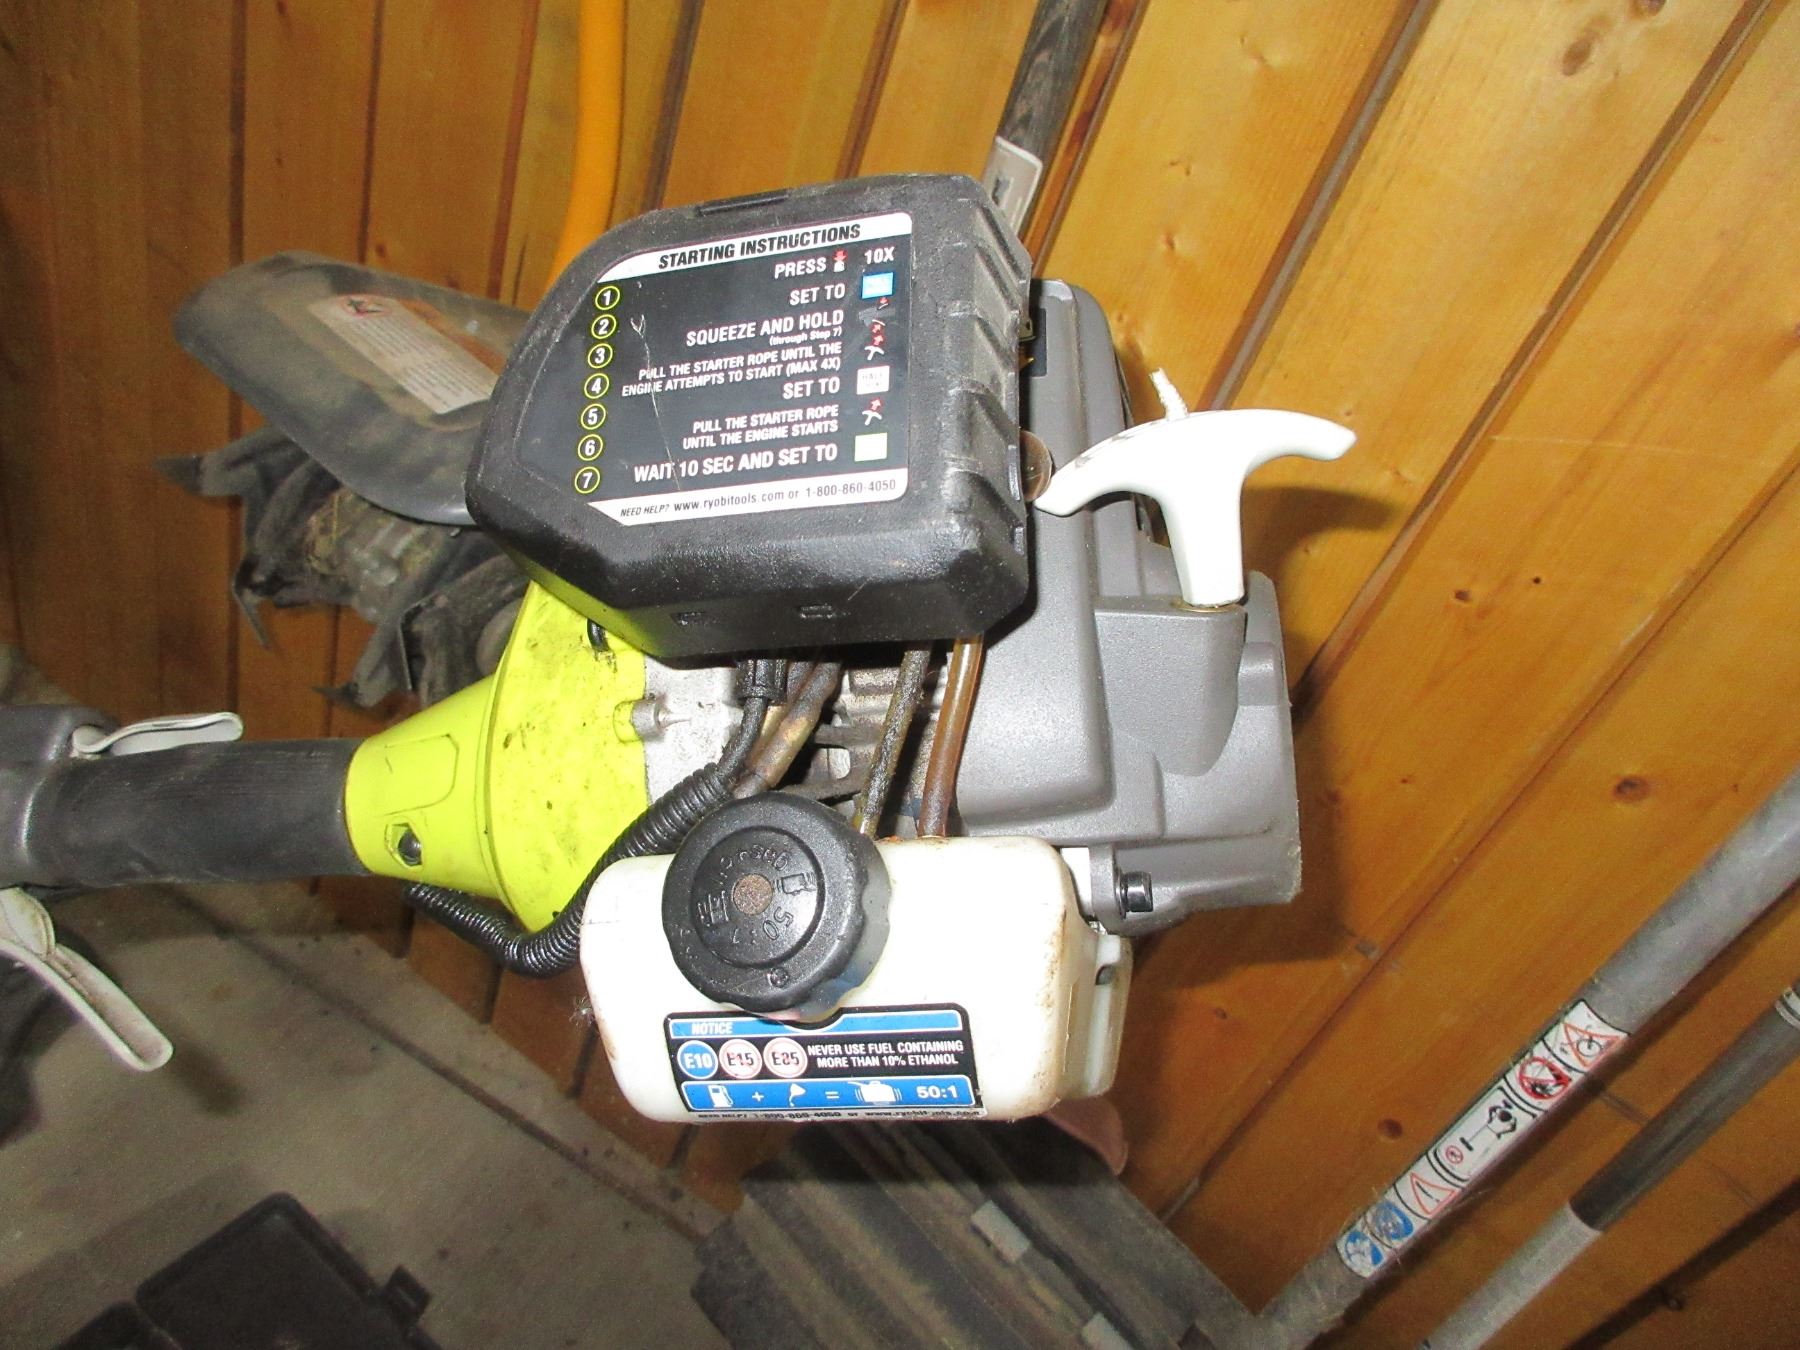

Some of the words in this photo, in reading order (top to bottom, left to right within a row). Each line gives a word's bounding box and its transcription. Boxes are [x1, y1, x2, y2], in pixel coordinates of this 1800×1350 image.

[658, 243, 735, 269] STARTING
[740, 223, 861, 257] INSTRUCTIONS
[864, 246, 895, 265] 10X
[774, 257, 827, 279] PRESS
[603, 290, 611, 306] 1
[789, 287, 819, 306] SET
[824, 283, 846, 300] TO
[598, 318, 609, 335] 2
[686, 322, 757, 347] SQUEEZE
[759, 316, 794, 336] AND
[799, 309, 844, 331] HOLD
[769, 332, 808, 346] (through
[809, 330, 830, 341] Step
[832, 327, 843, 337] 7)
[594, 347, 605, 364] 3
[638, 366, 666, 381] PULL
[669, 362, 691, 377] THE
[693, 355, 745, 374] STARTER
[747, 350, 778, 366] ROPE
[781, 345, 815, 361] UNTIL
[819, 341, 842, 356] THE
[591, 377, 602, 394] 4
[621, 380, 663, 397] ENGINE
[664, 372, 725, 392] ATTEMPTS
[728, 369, 743, 383] TO
[745, 364, 783, 381] START
[785, 359, 818, 377] (MAX
[820, 356, 841, 371] 4X)
[782, 380, 814, 400] SET
[818, 376, 840, 395] TO
[587, 407, 598, 425] 5
[692, 419, 721, 434] PULL
[725, 415, 748, 430] THE
[750, 408, 804, 427] STARTER
[806, 404, 839, 420] ROPE
[682, 435, 717, 450] UNTIL
[720, 431, 743, 446] THE
[744, 425, 789, 443] ENGINE
[791, 419, 839, 437] STARTS
[584, 439, 595, 456] 6
[633, 462, 675, 483] WAIT
[679, 459, 699, 478] 10
[702, 455, 734, 476] SEC
[737, 450, 774, 471] AND
[778, 446, 811, 466] SET
[814, 443, 838, 462] TO
[582, 471, 593, 489] 7
[620, 507, 642, 517] NEED
[643, 504, 670, 514] HELP?
[674, 490, 785, 512] www.ryobitools.com
[788, 489, 799, 501] or
[805, 479, 896, 498] 1-800-860-4050
[691, 1021, 733, 1035] NOTICE
[807, 1044, 844, 1056] NEVER
[844, 1043, 866, 1055] USE
[868, 1042, 895, 1054] FUEL
[897, 1039, 964, 1053] CONTAINING
[683, 1052, 713, 1069] E10
[726, 1051, 754, 1067] E15
[771, 1050, 800, 1066] E85
[816, 1056, 849, 1068] MORE
[850, 1056, 880, 1067] THAN
[882, 1055, 906, 1066] 10%
[908, 1053, 959, 1066] ETHANOL
[916, 1085, 958, 1099] 50:1
